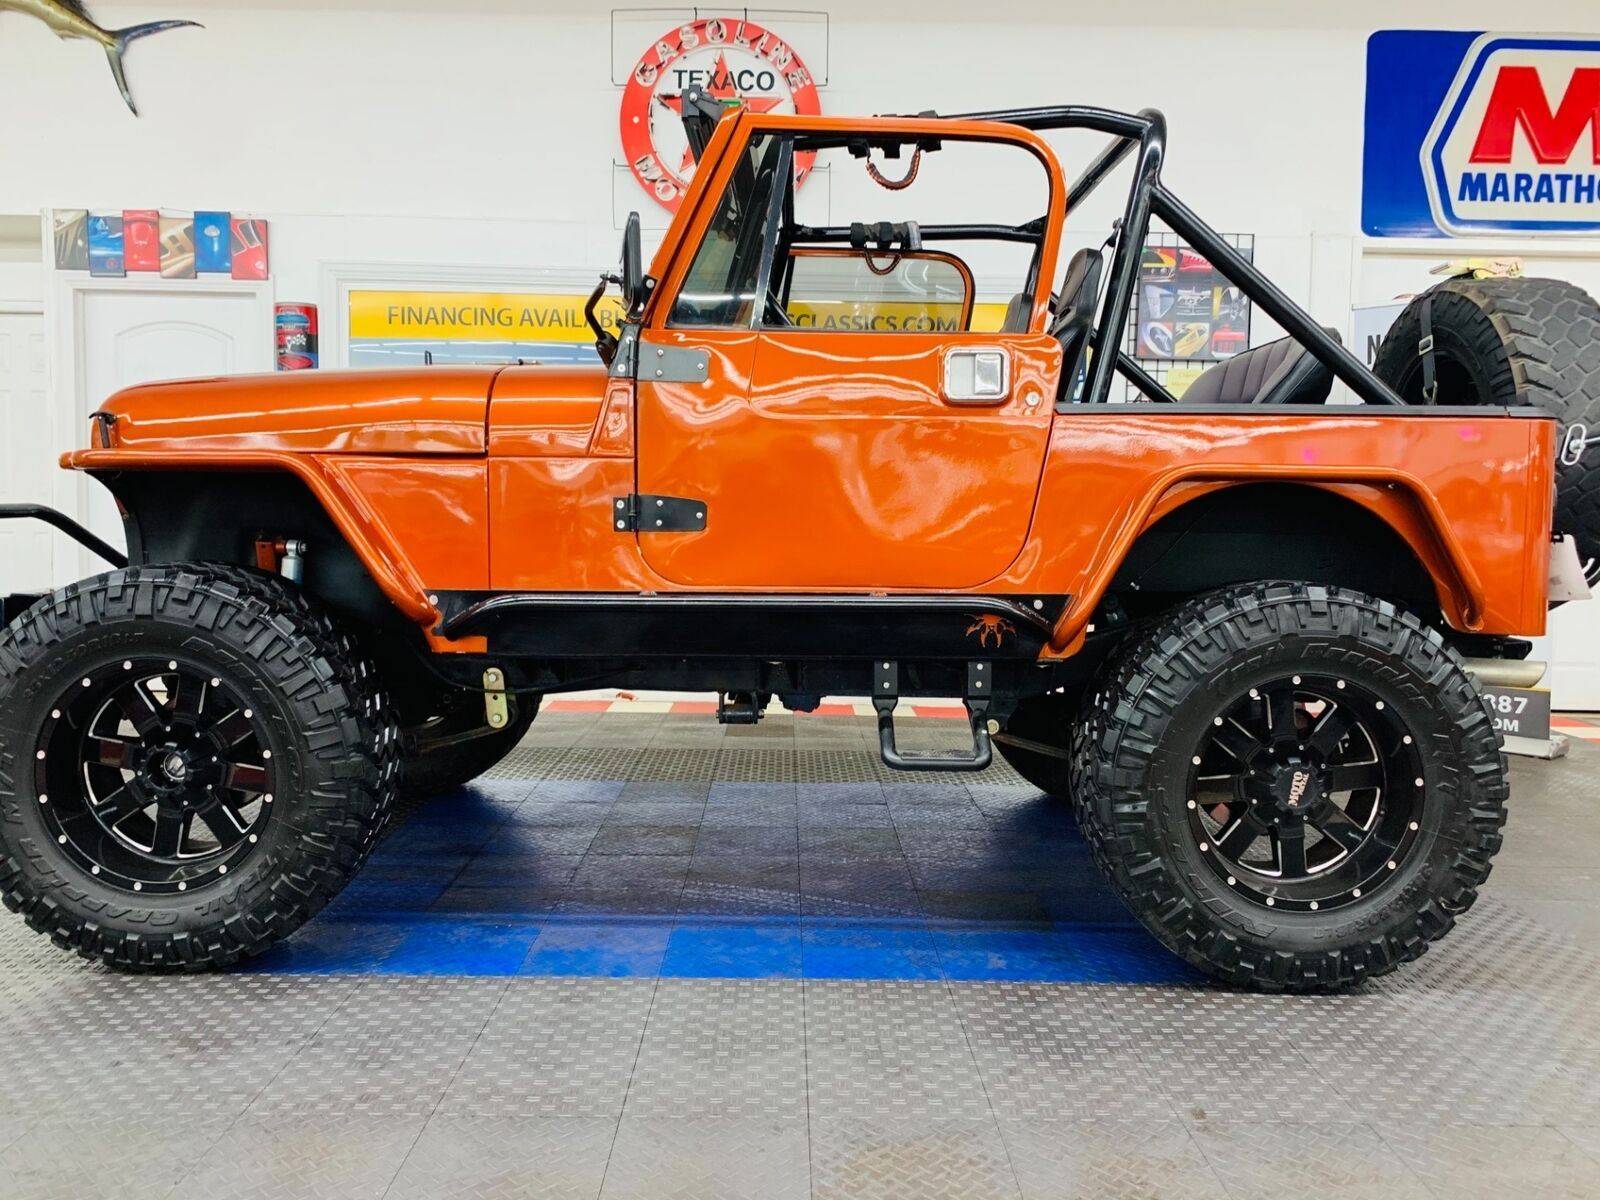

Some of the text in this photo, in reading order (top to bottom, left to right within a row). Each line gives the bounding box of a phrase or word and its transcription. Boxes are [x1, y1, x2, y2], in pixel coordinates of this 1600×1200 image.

[634, 18, 811, 93] GASOLINE
[672, 69, 775, 92] TEXACO
[1458, 171, 1600, 204] MARATH
[387, 305, 513, 327] FINANCING
